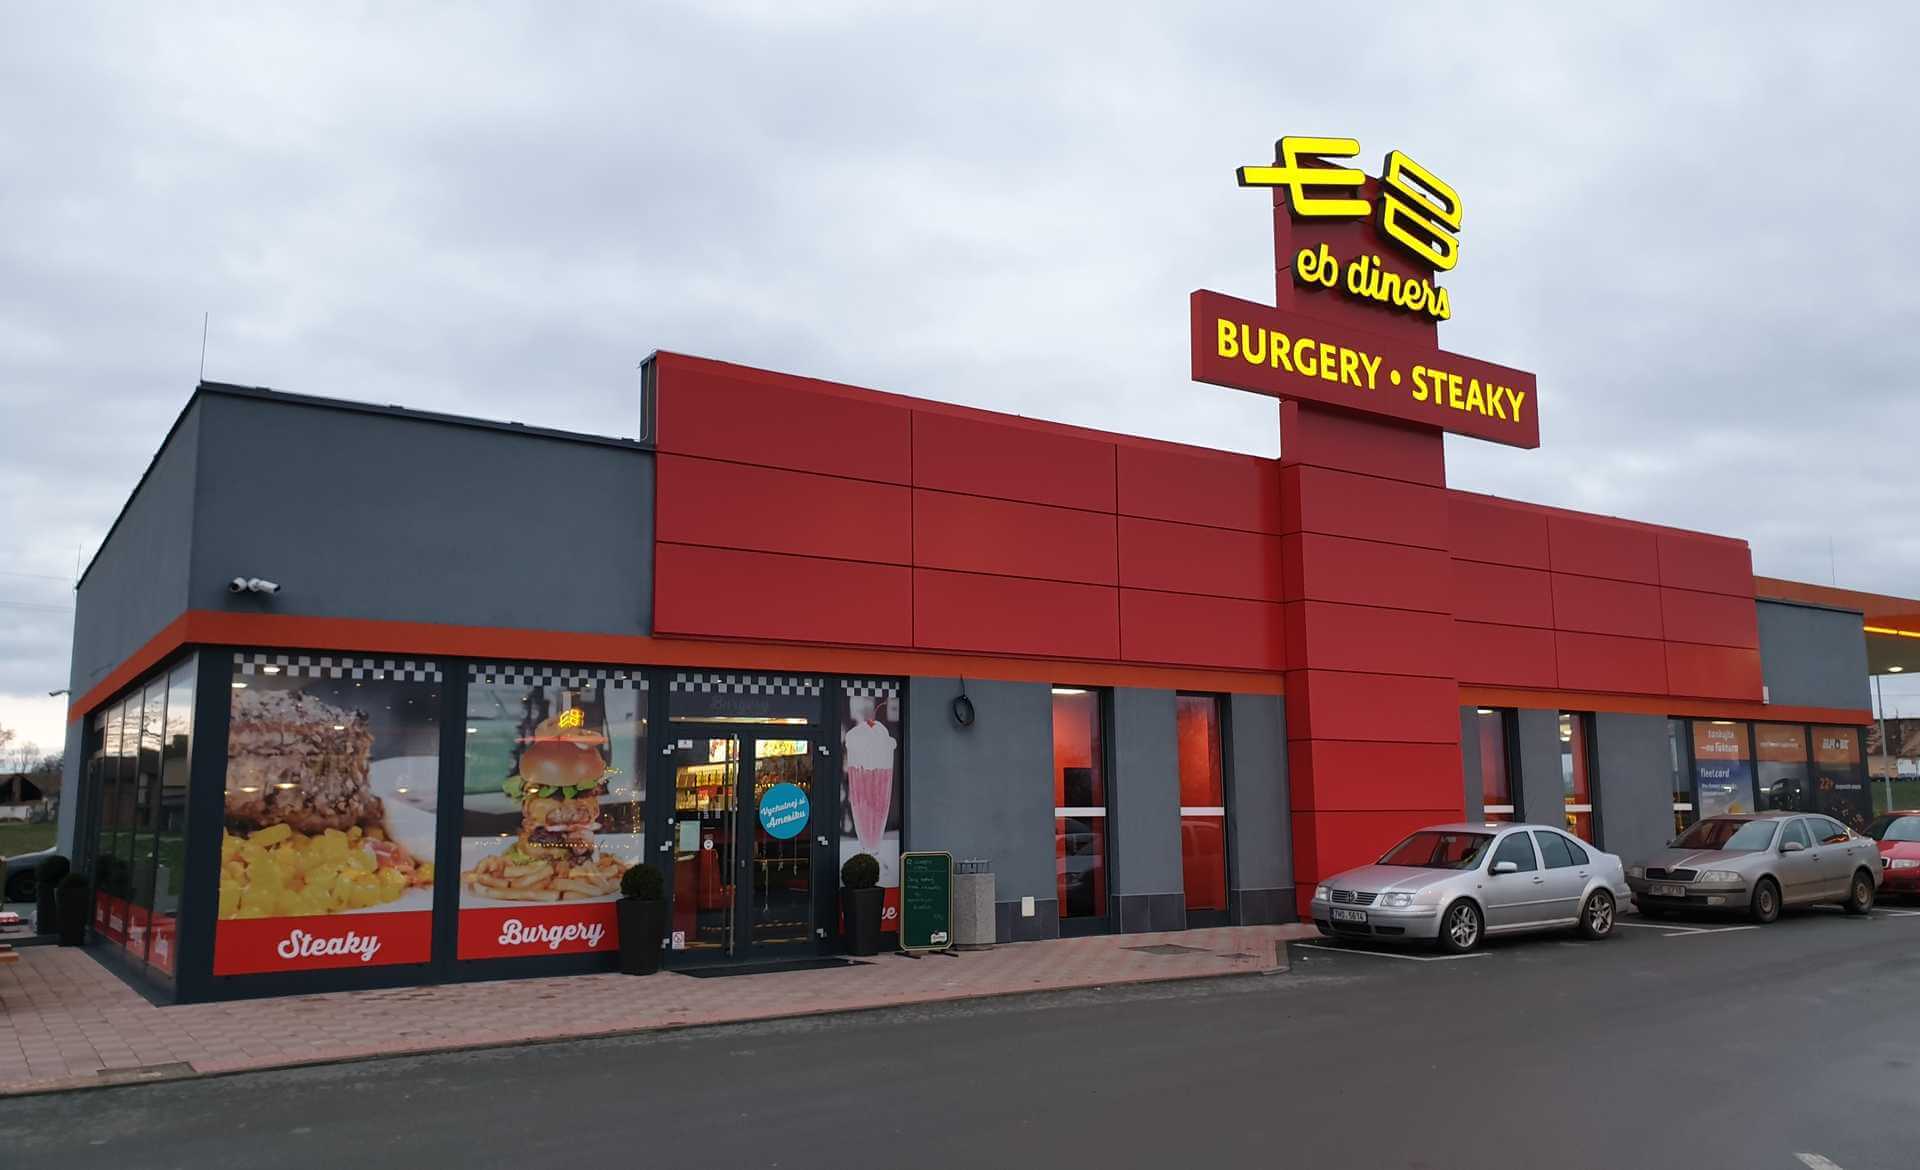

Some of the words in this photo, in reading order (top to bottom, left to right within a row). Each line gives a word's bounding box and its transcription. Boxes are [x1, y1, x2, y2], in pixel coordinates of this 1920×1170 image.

[1296, 242, 1338, 288] eb
[1346, 254, 1451, 320] diners
[1216, 317, 1382, 390] BURGERY
[1411, 365, 1526, 423] STEAKY
[277, 929, 382, 962] Steaky
[498, 919, 606, 950] Burgery
